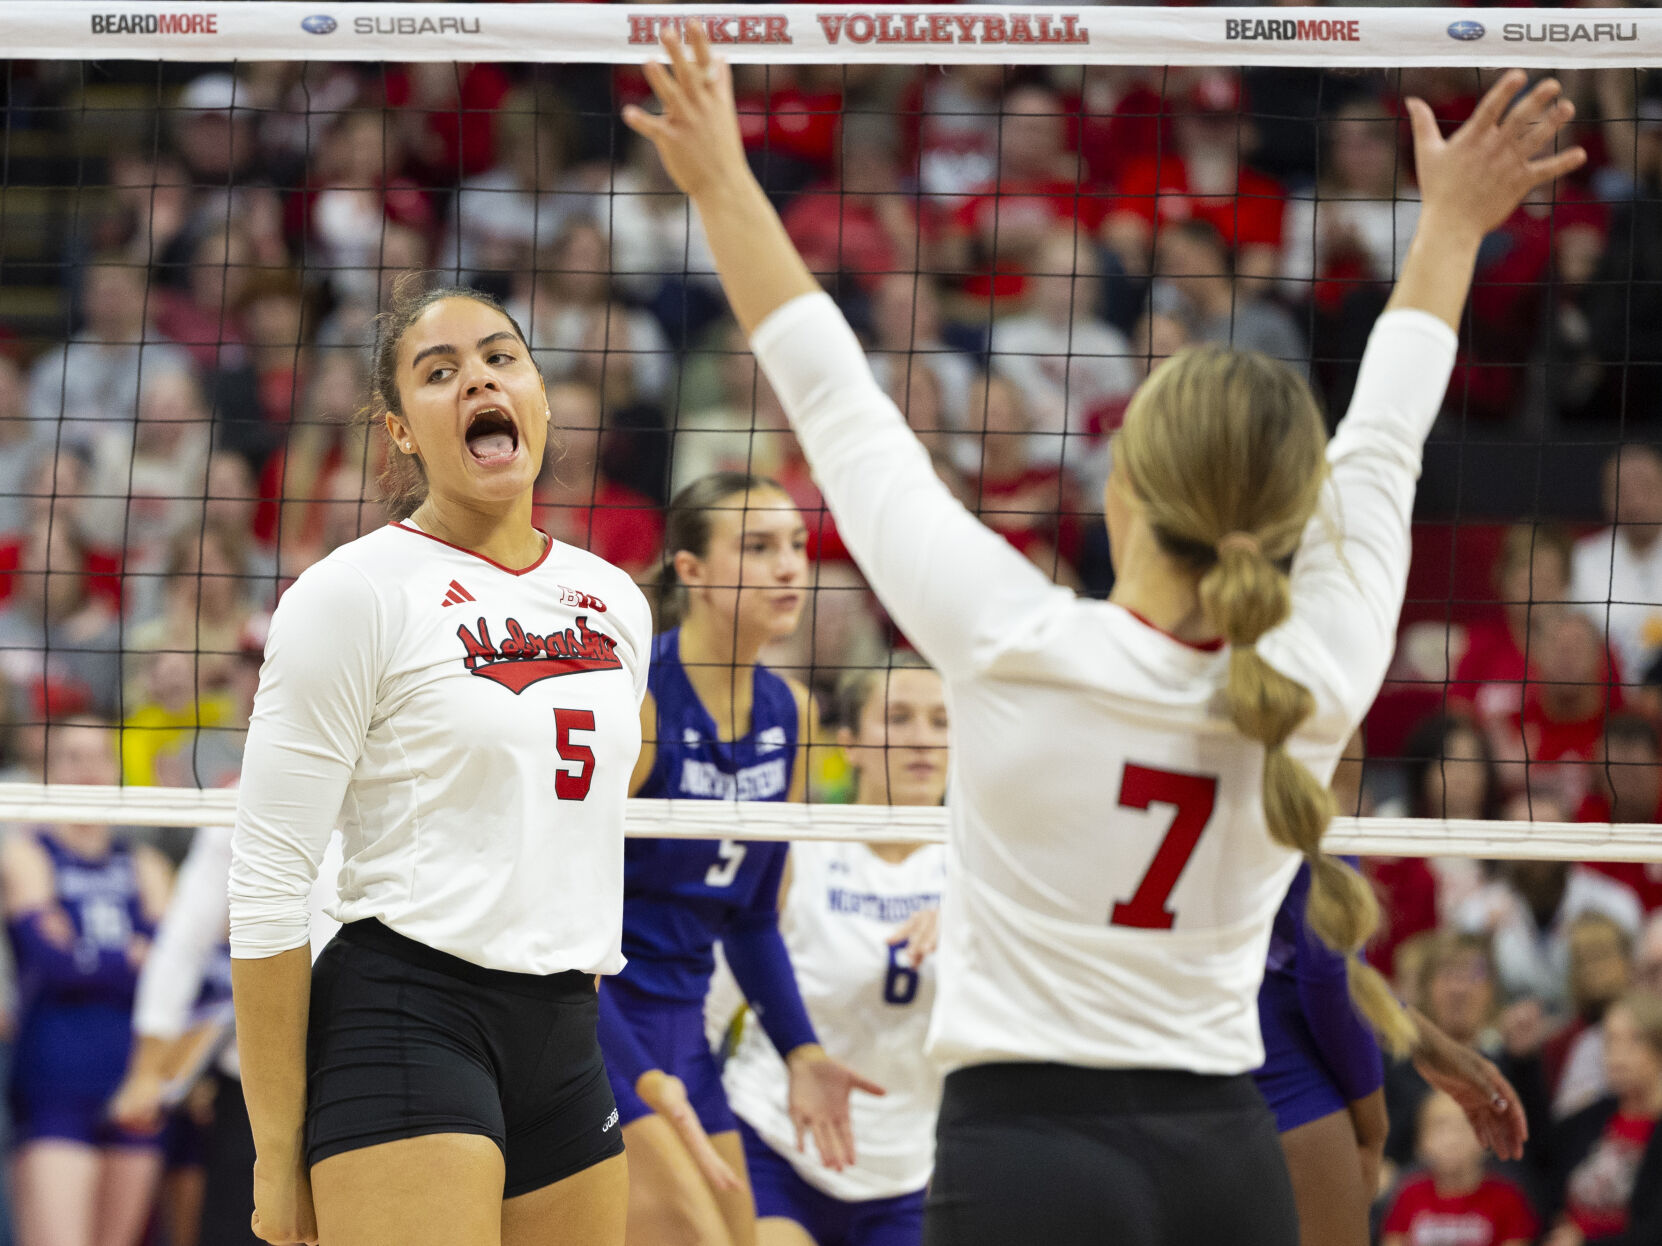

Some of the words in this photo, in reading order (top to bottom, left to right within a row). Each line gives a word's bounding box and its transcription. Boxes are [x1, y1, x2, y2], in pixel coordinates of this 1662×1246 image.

[91, 14, 217, 34] BEARDMORE
[354, 17, 481, 34] SUBARU
[816, 13, 1089, 45] VOLLEYBALL
[1225, 19, 1360, 41] BEARDMORE
[1503, 23, 1638, 42] SUBARU
[456, 616, 617, 669] Nebraska
[552, 707, 596, 801] 5
[1109, 761, 1219, 931] 7
[883, 937, 920, 1005] 6
